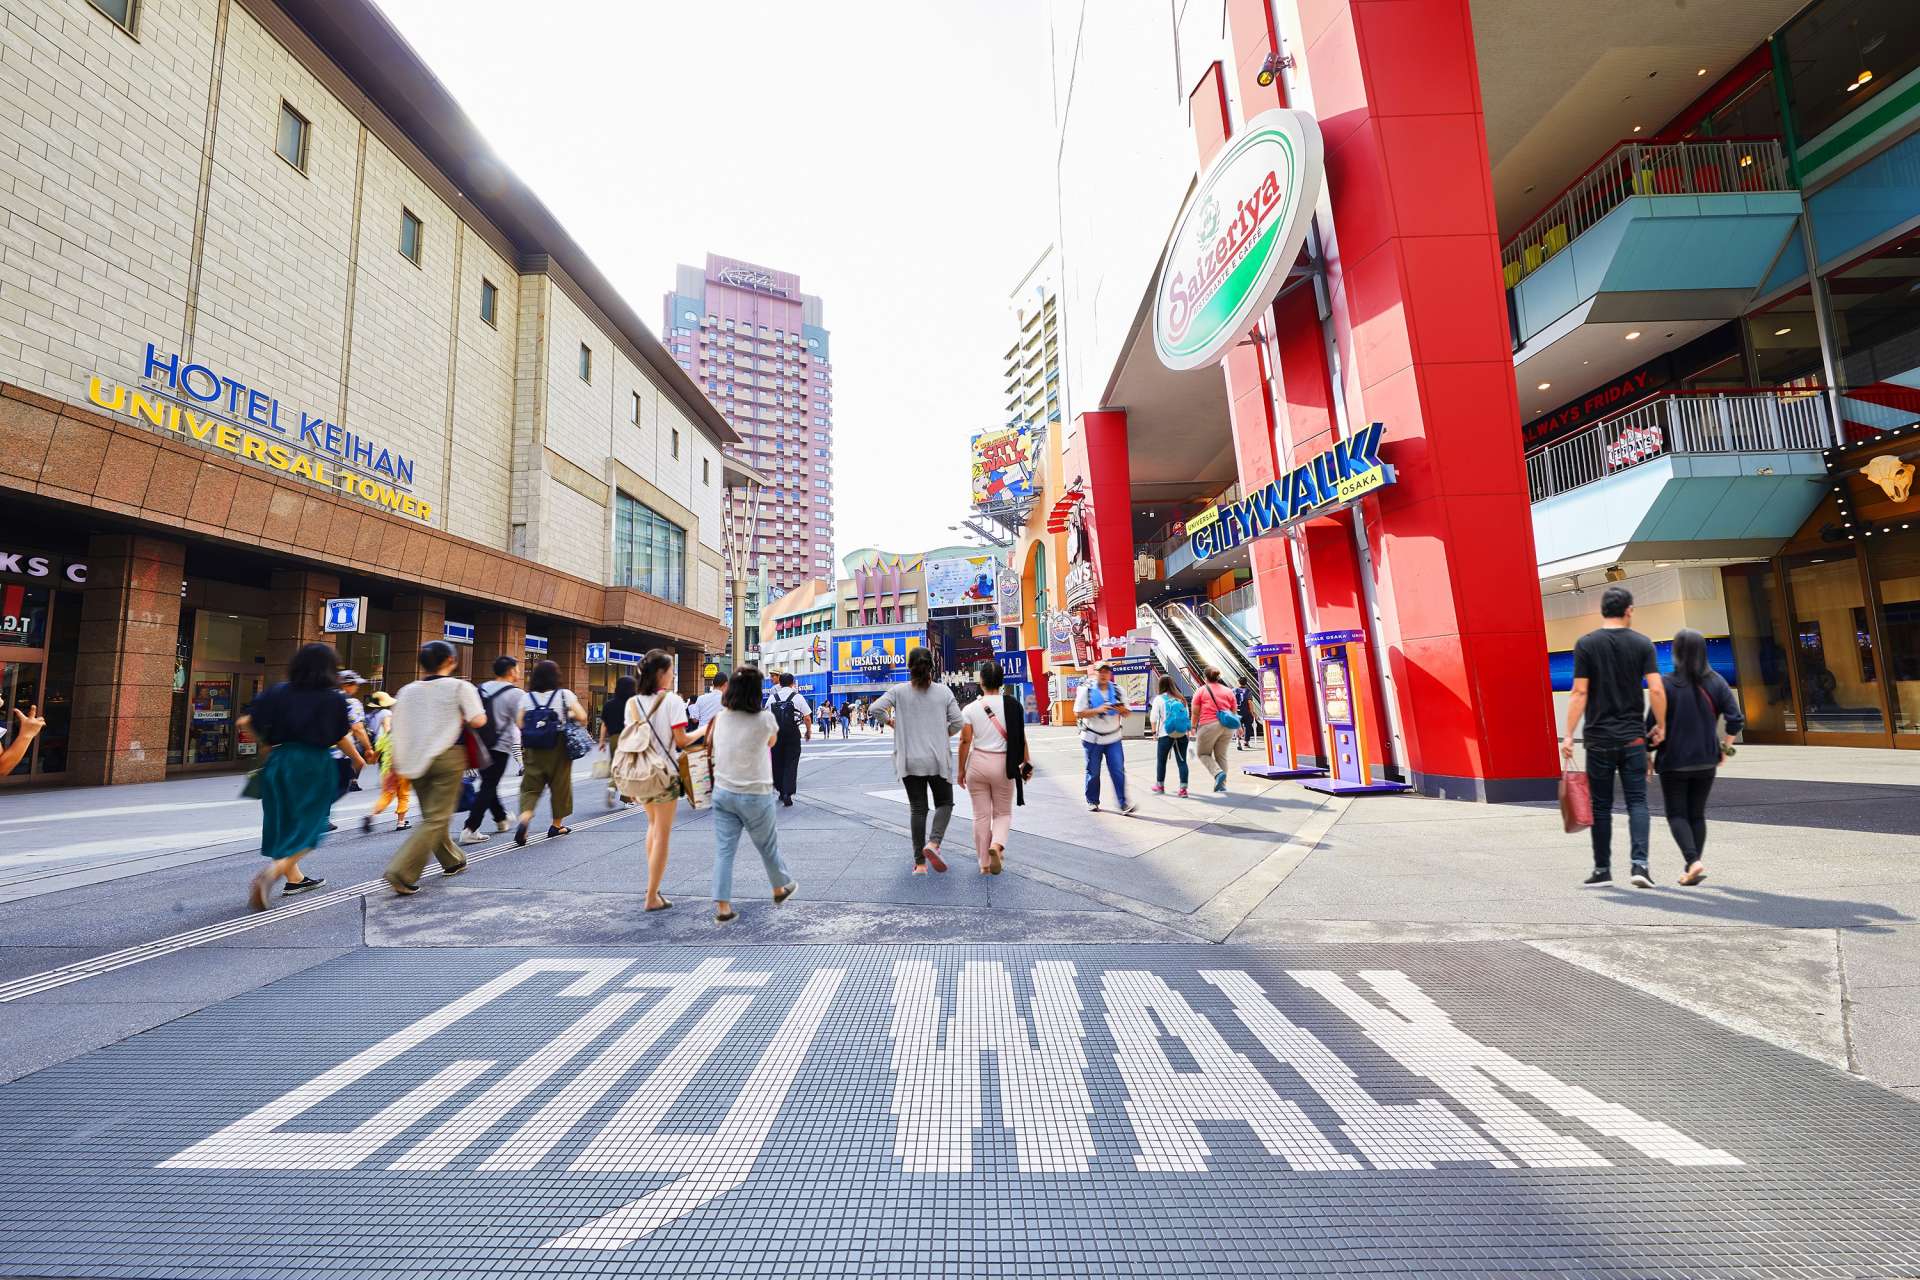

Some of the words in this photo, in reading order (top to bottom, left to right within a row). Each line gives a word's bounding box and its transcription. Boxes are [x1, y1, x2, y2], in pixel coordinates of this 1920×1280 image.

[1169, 170, 1280, 334] Saizeriya
[144, 342, 286, 433] HOTEL
[300, 411, 414, 484] KEIHAN
[88, 375, 333, 487] UNIVERSAL
[339, 470, 433, 521] TOWER
[981, 448, 1029, 472] WALK
[982, 438, 1019, 460] CITY
[1190, 422, 1385, 560] CITYWALK
[1342, 473, 1378, 496] OSAKA
[1187, 512, 1217, 531] UNIVERSAL
[875, 654, 905, 665] STUDIOS
[1000, 657, 1022, 675] GAP
[888, 956, 1747, 1173] WALK
